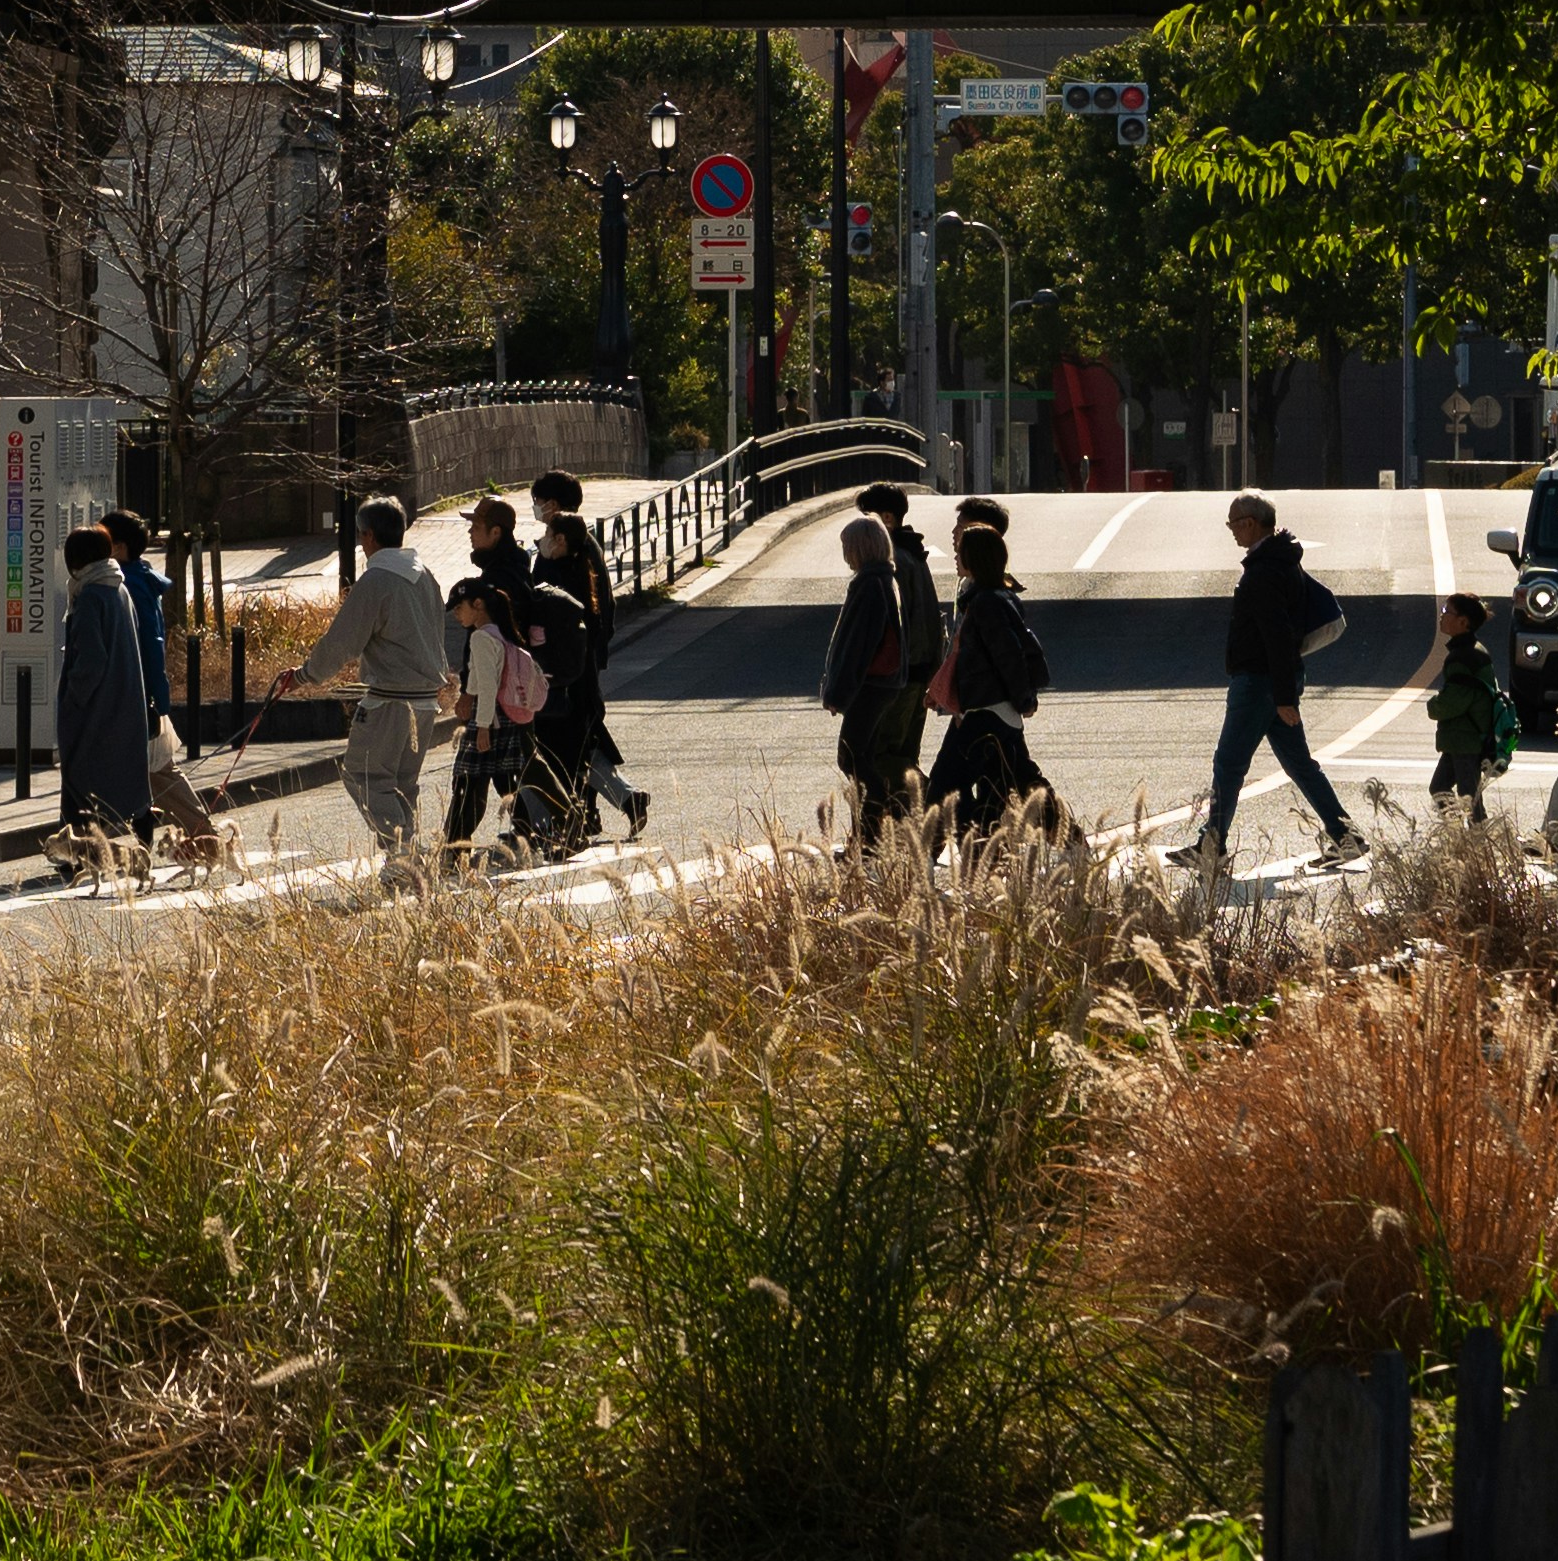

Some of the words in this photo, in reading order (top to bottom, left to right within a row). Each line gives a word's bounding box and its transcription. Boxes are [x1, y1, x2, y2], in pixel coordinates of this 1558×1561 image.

[965, 84, 1042, 100] 墨田区役所前
[968, 100, 996, 110] Sumida
[999, 100, 1014, 112] City
[1016, 100, 1040, 110] Office
[29, 430, 46, 493] Tourist
[29, 498, 45, 634] INFORMATION
